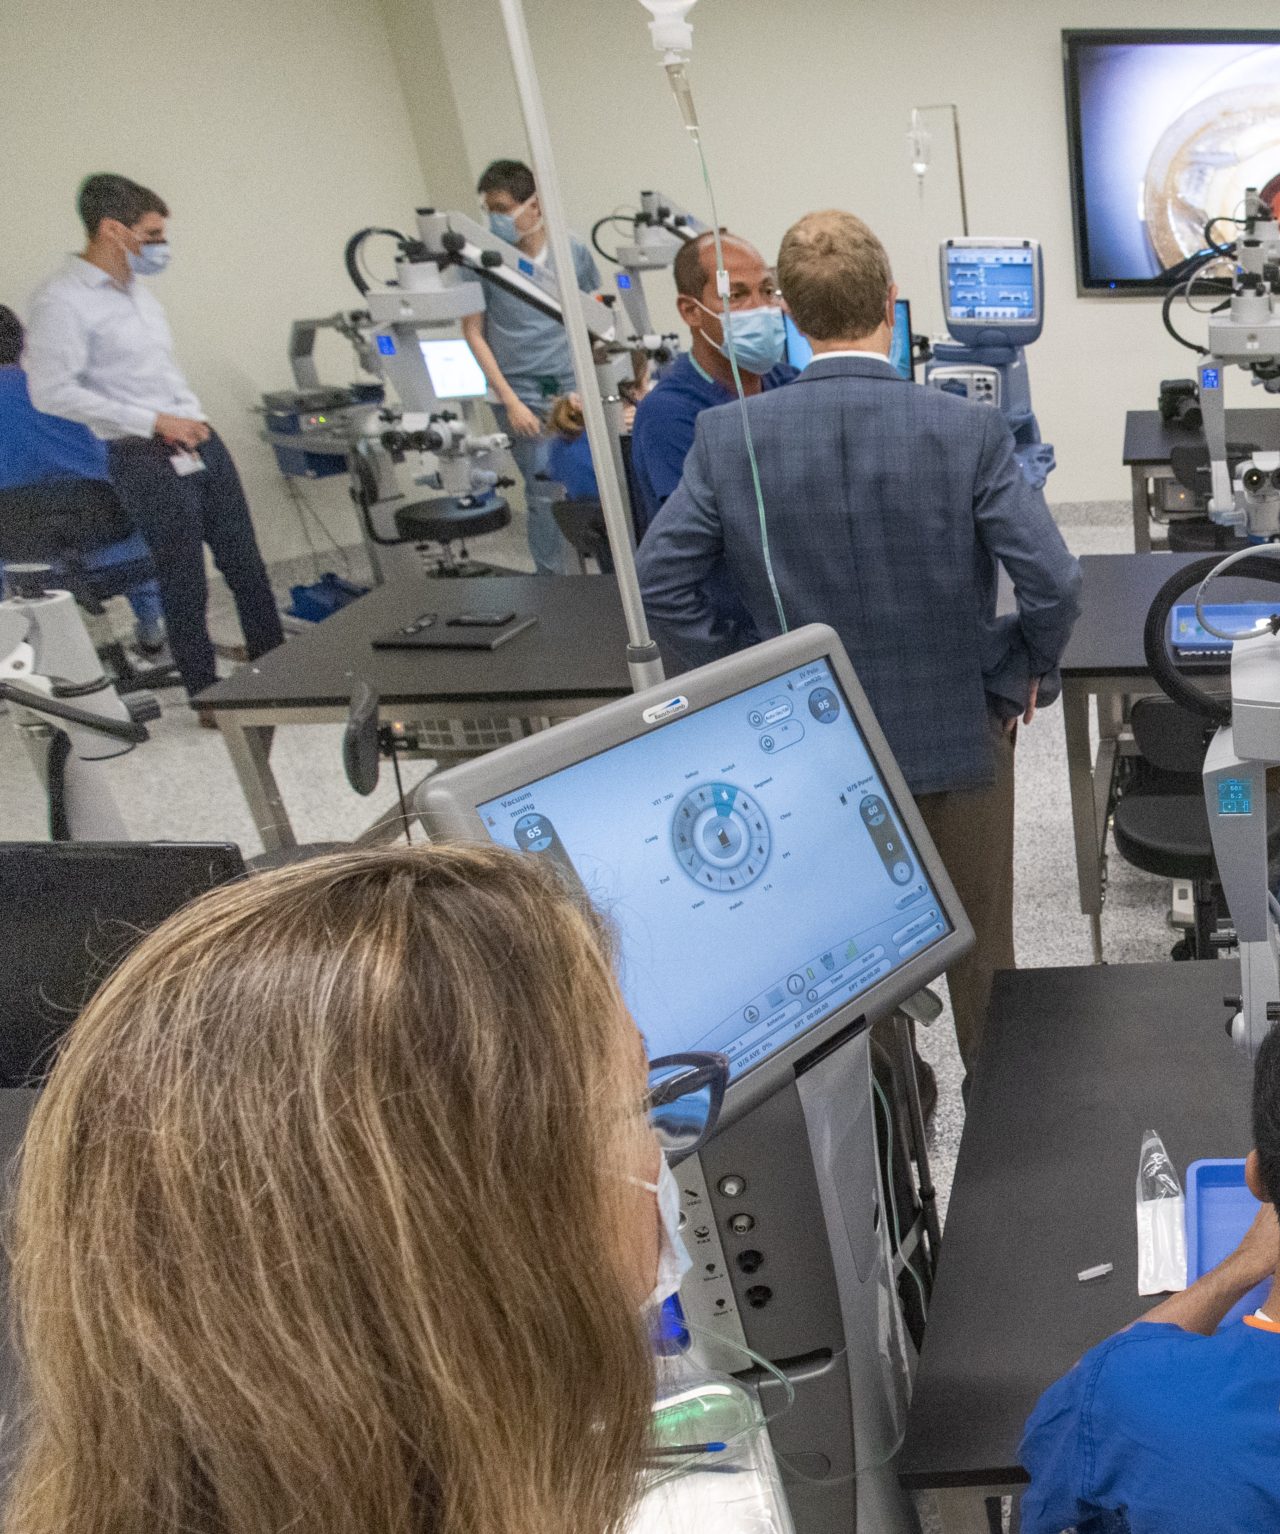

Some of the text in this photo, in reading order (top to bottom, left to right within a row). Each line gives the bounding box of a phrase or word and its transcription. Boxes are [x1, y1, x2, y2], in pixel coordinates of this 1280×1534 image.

[818, 699, 830, 711] 95
[501, 791, 532, 808] Vacuum
[510, 803, 535, 818] mmHg
[868, 805, 879, 816] 60
[526, 826, 542, 839] 65
[886, 842, 893, 851] 0
